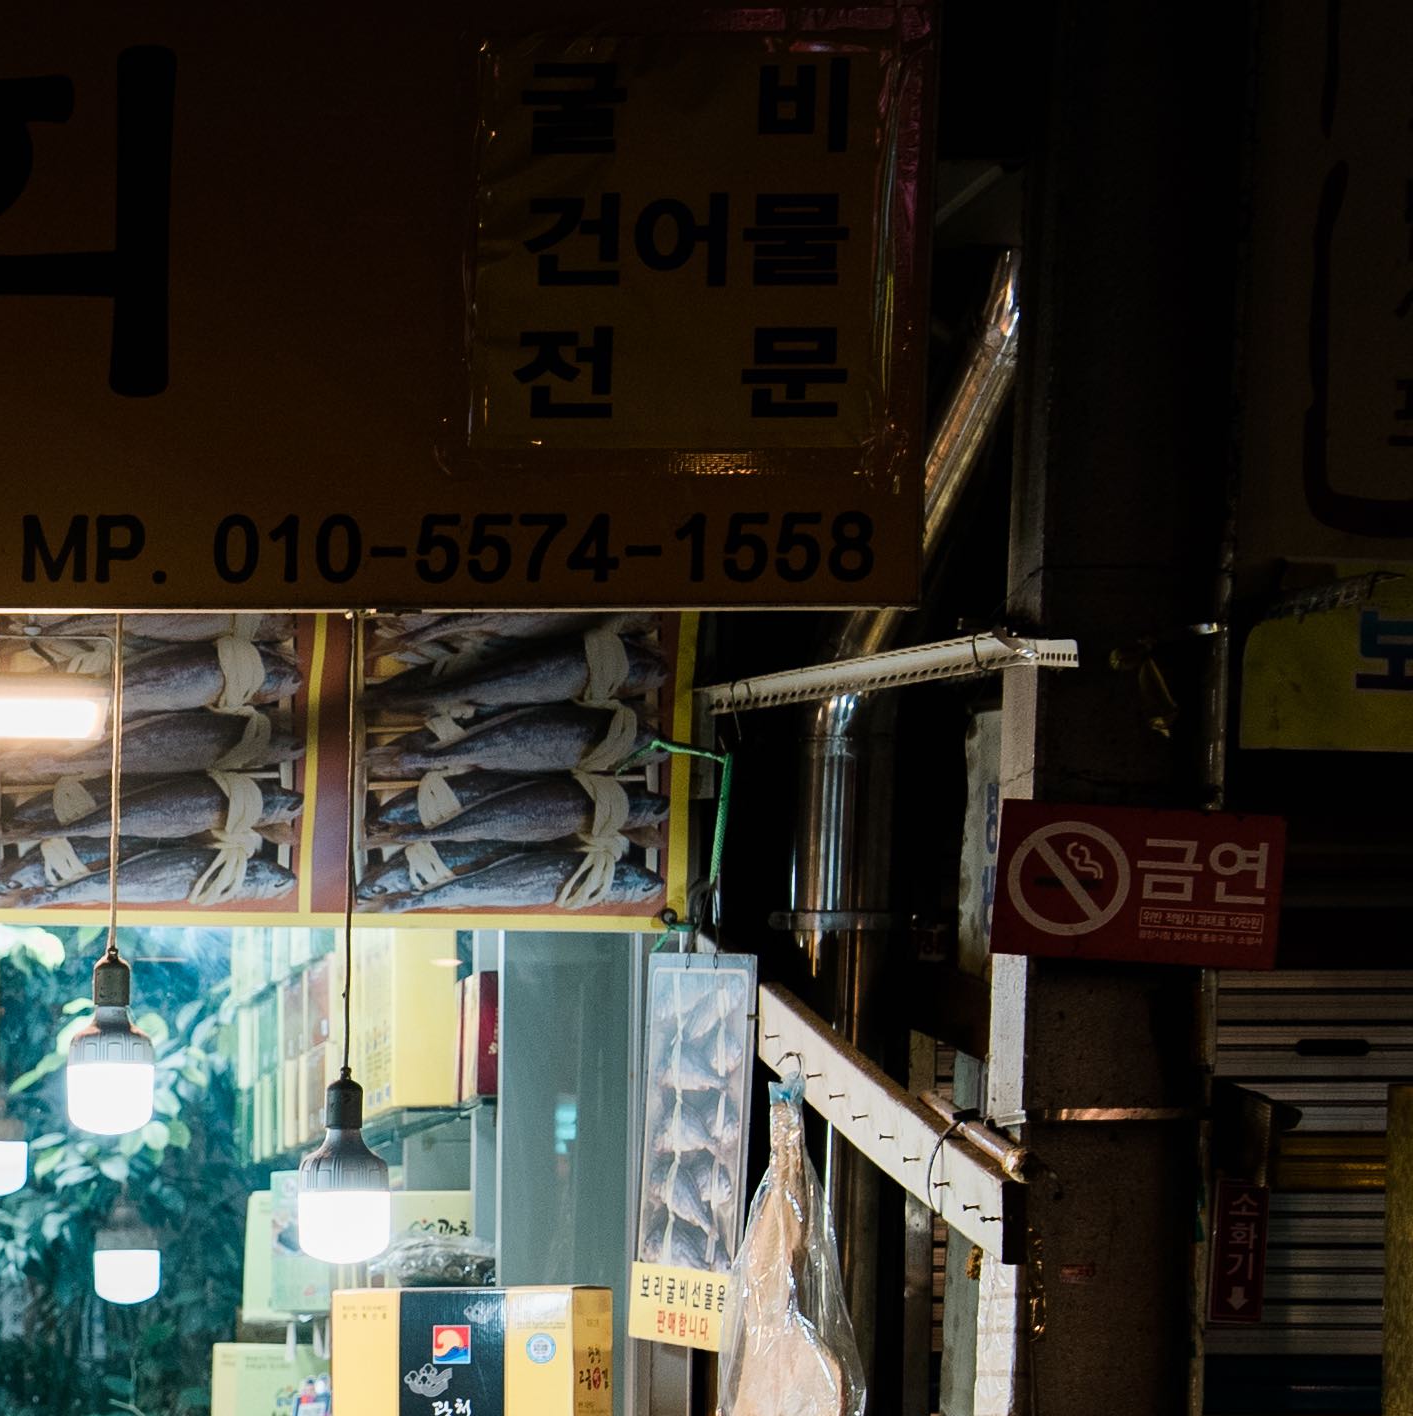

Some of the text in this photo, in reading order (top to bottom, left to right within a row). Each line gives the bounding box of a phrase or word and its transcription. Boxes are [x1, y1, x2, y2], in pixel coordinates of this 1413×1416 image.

[523, 193, 851, 287] 건어물
[22, 510, 876, 585] MP. 010-5574-1558
[1137, 837, 1269, 905] 금연
[1228, 1190, 1262, 1283] 소화기
